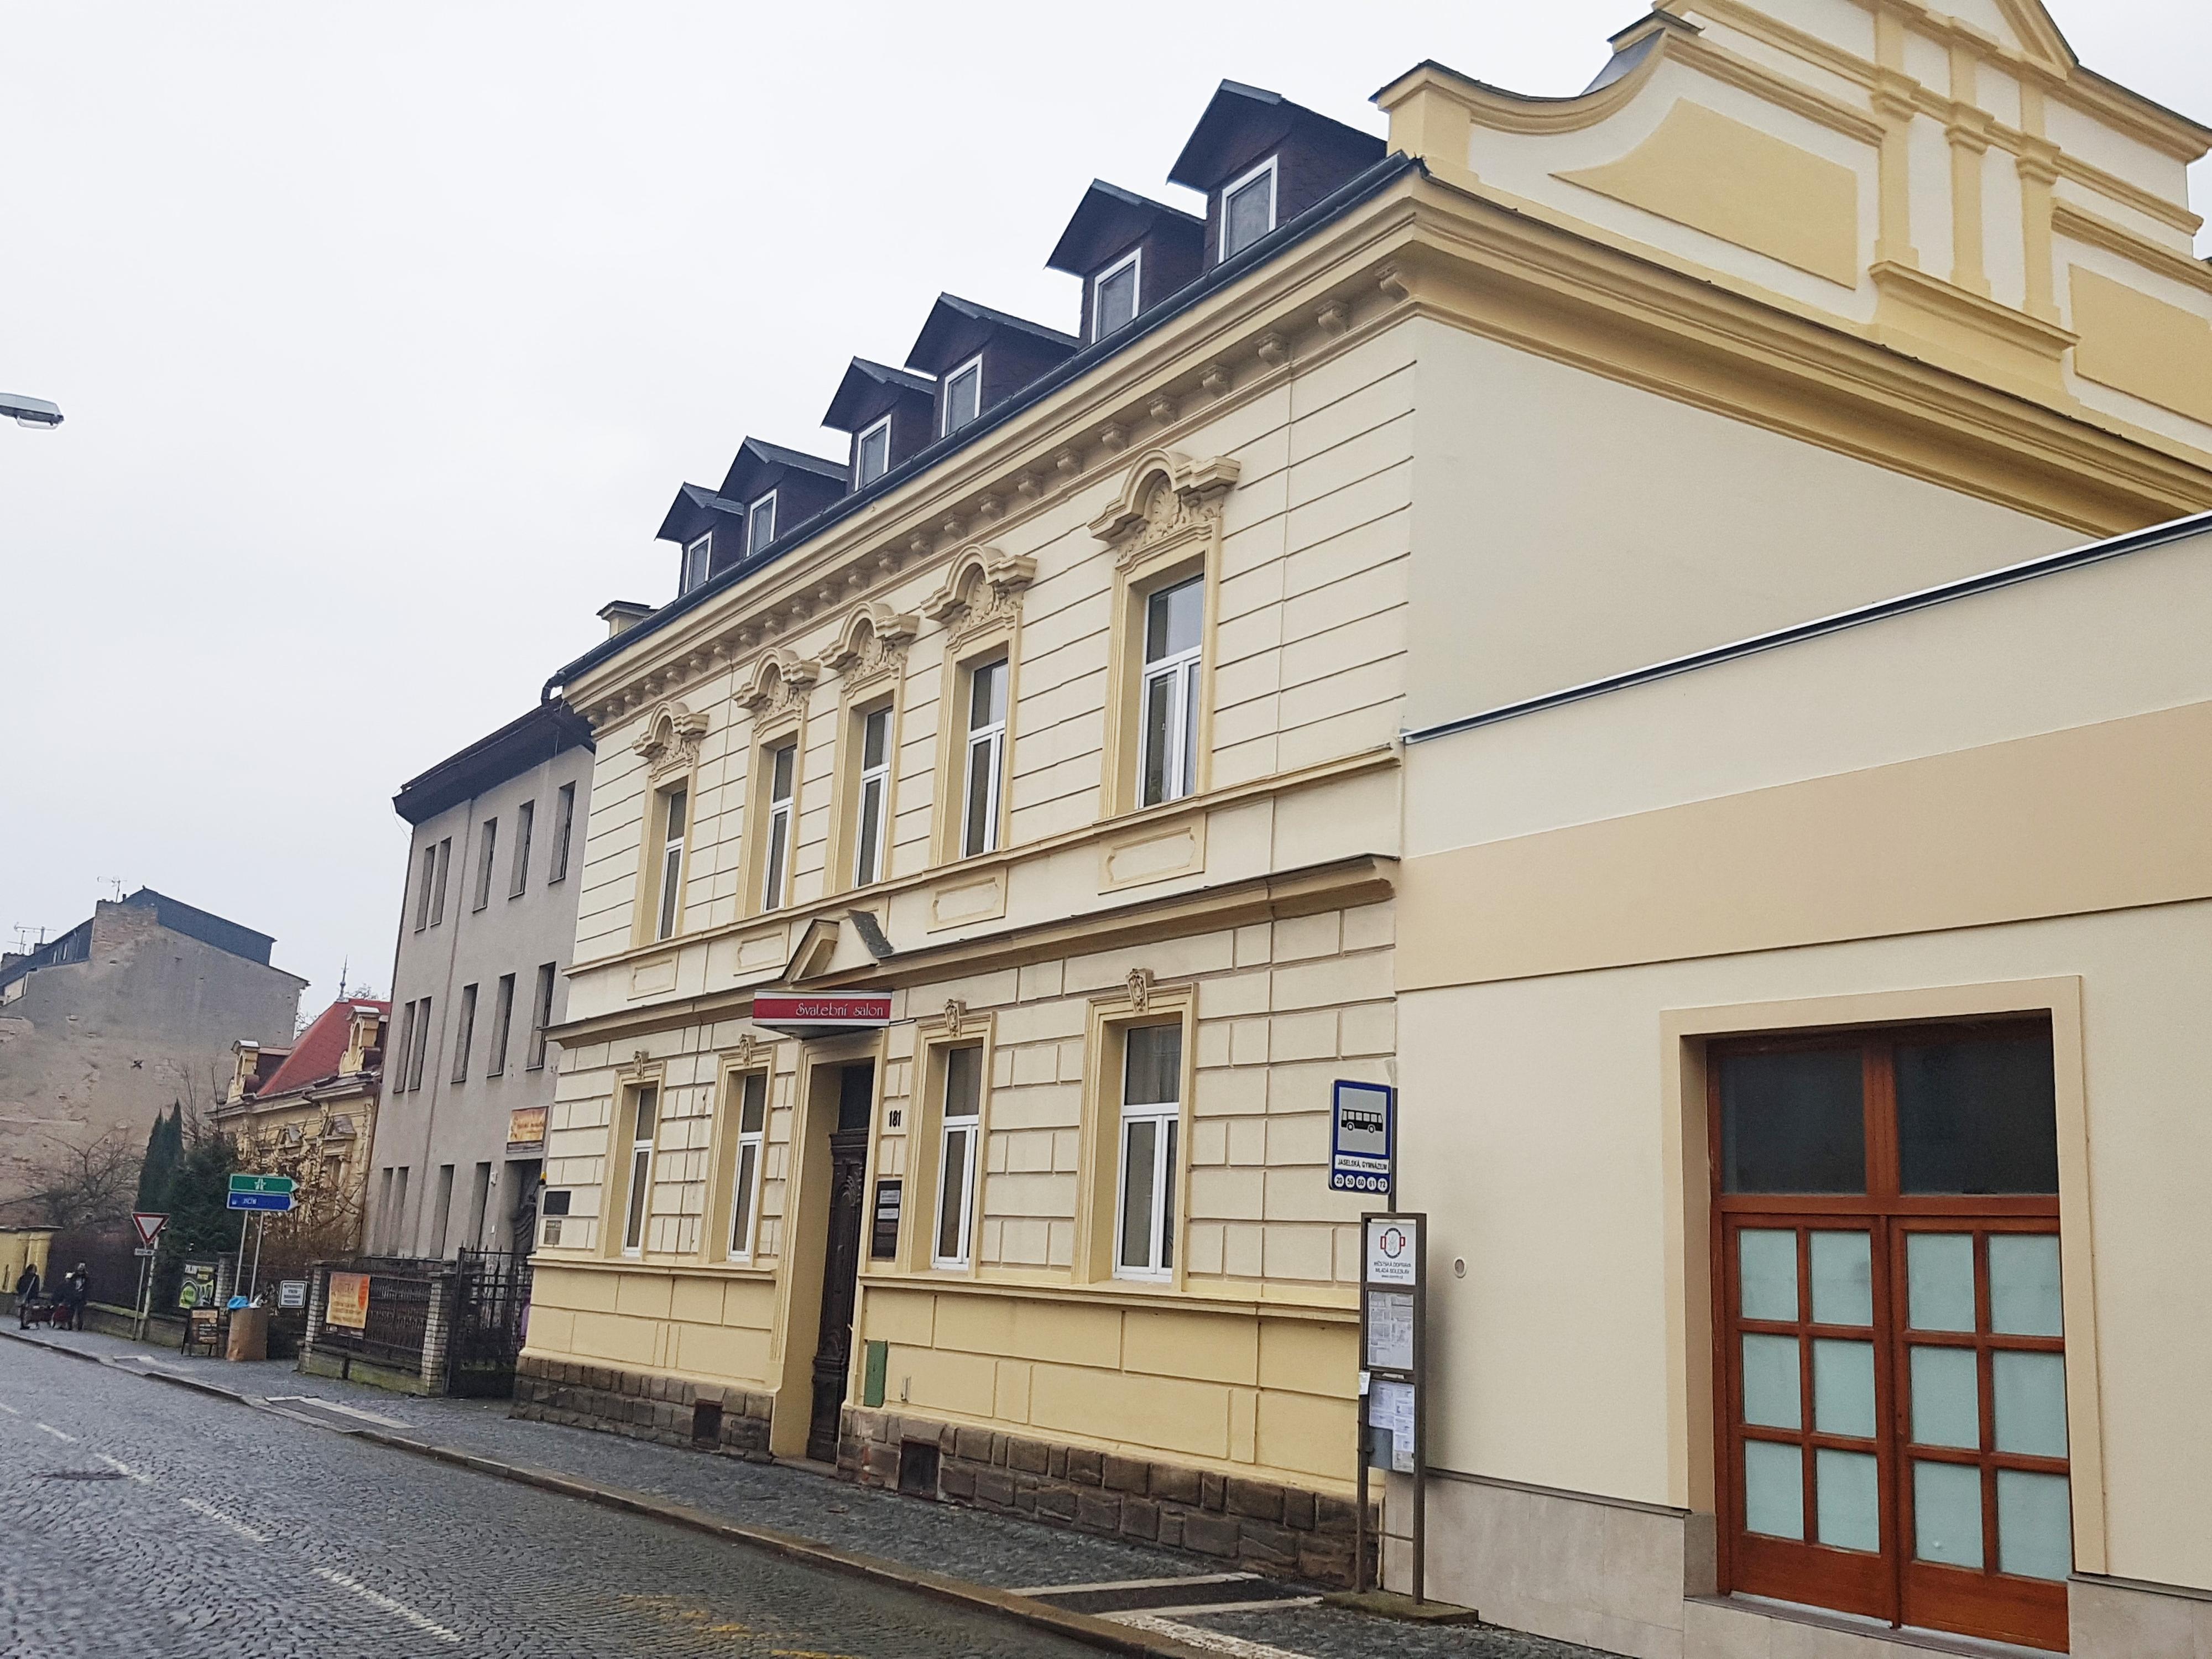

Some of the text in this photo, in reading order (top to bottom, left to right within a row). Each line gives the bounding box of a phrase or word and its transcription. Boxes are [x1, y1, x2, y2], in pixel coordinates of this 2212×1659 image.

[795, 1002, 884, 1016] Svatební salon
[889, 1110, 902, 1127] 181
